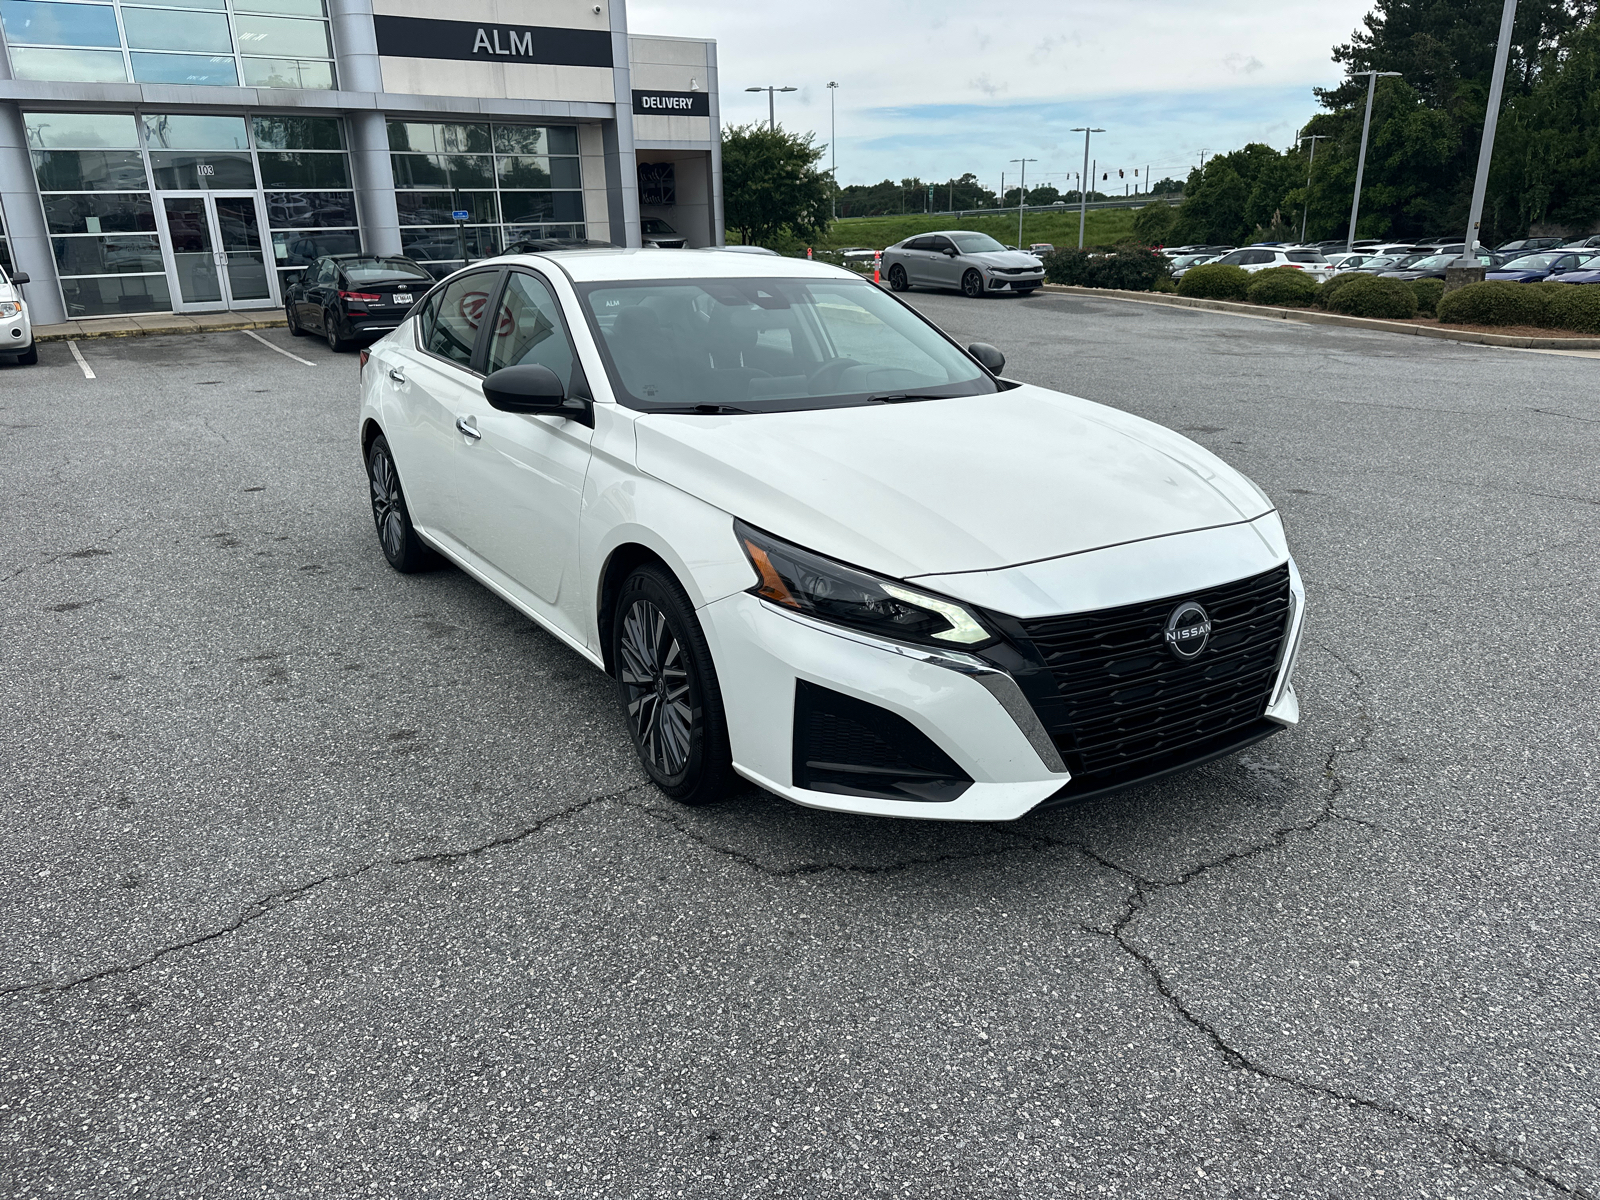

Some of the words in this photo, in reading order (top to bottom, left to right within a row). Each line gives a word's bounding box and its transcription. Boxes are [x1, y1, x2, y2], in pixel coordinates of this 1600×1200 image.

[472, 28, 533, 56] ALM
[643, 96, 693, 109] DELIVERY
[198, 165, 214, 175] 103
[1166, 622, 1211, 641] NISSAN
